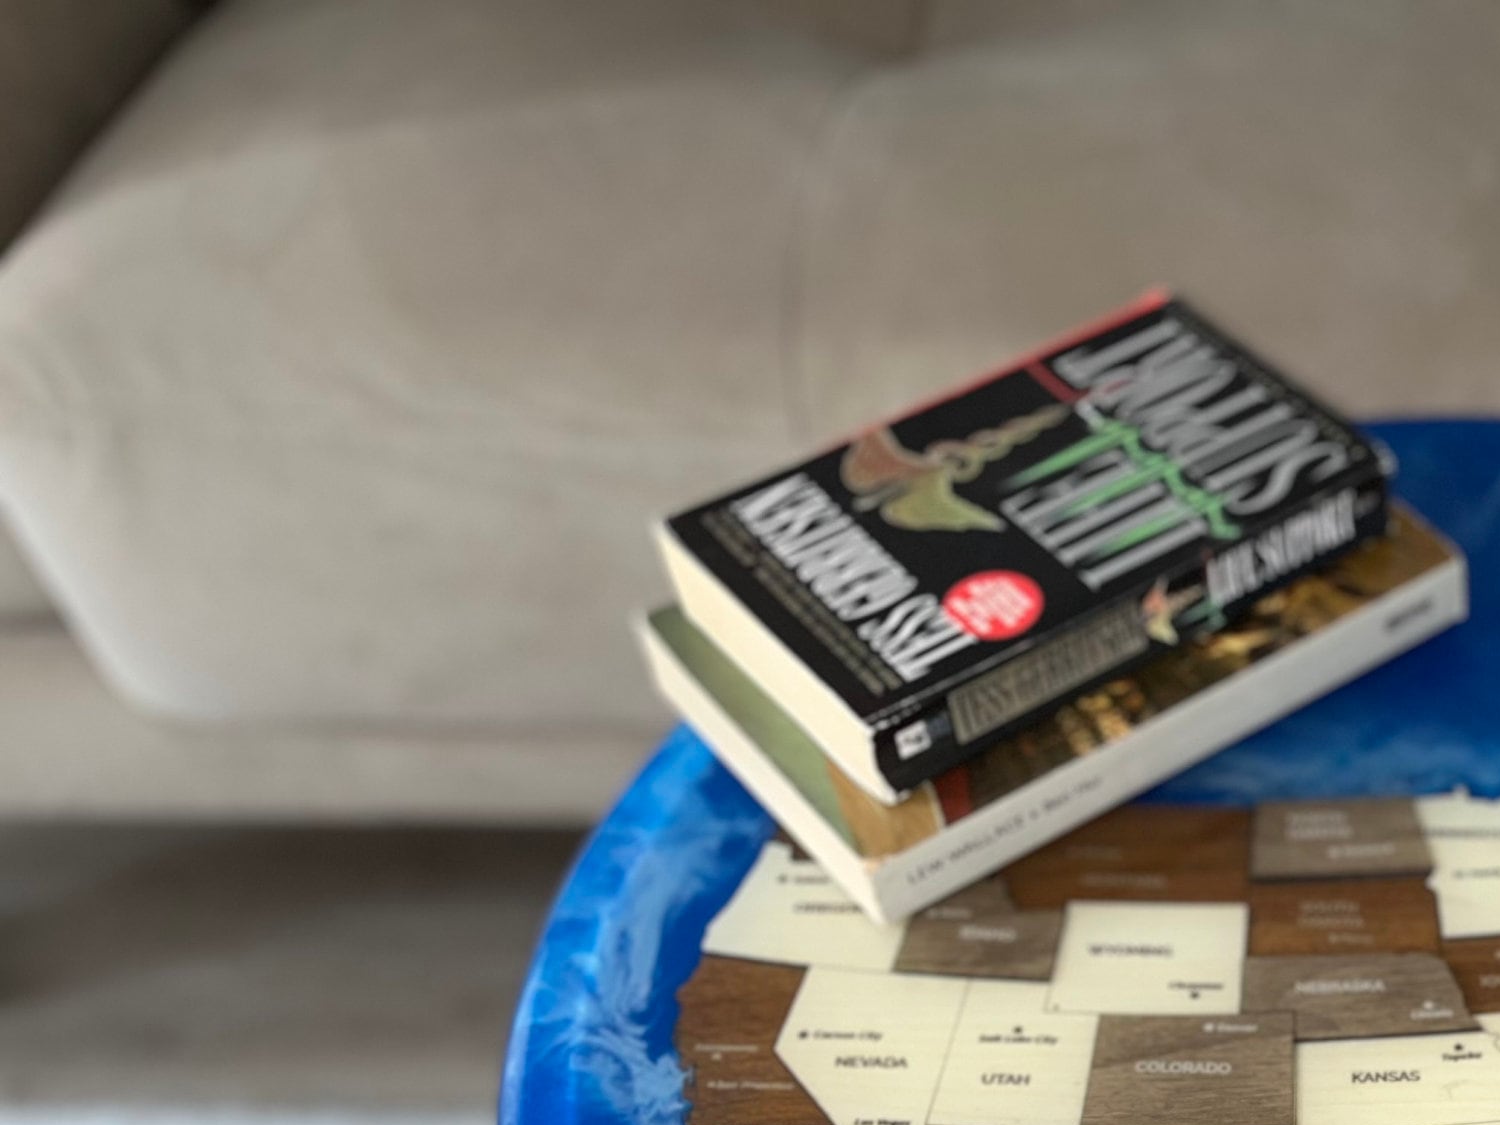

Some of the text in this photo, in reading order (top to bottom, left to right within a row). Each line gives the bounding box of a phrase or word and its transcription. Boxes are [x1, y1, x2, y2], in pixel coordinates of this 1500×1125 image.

[1053, 318, 1349, 516] SUPPORT
[730, 471, 919, 621] GERRITSEN
[1000, 448, 1208, 592] LIFE
[857, 592, 977, 682] TESS
[835, 1057, 908, 1069] NEVADA
[981, 1074, 1030, 1086] UTAH
[1135, 1061, 1231, 1075] COLORADO
[1351, 1071, 1420, 1084] KANSAS
